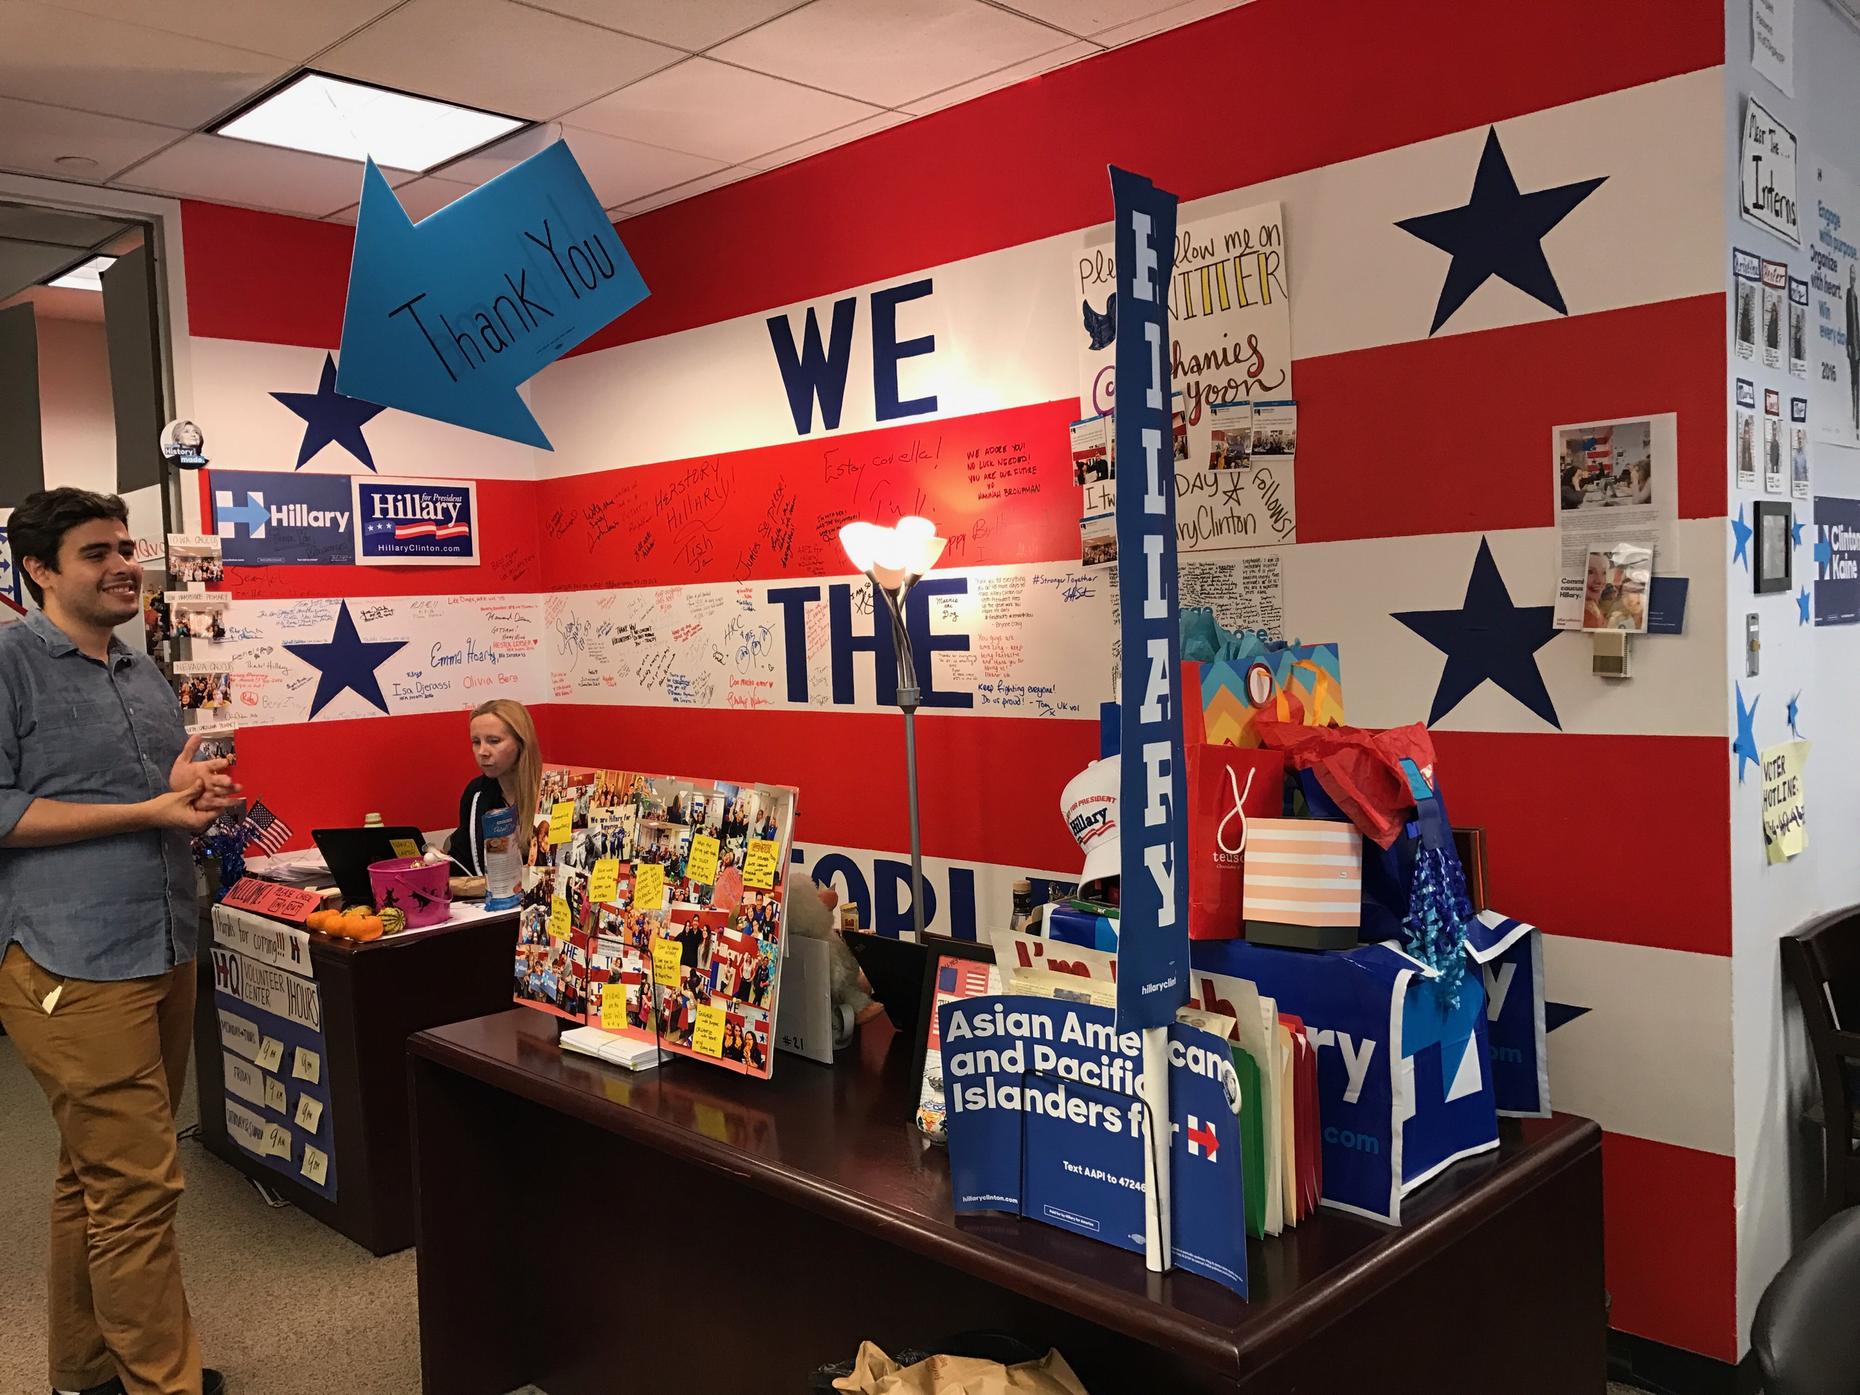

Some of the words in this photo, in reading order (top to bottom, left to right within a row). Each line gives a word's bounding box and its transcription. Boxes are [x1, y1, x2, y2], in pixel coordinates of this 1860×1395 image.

[1225, 228, 1254, 254] me
[1259, 223, 1281, 248] on
[1810, 244, 1837, 273] Organize
[1168, 250, 1288, 320] ITTER
[388, 267, 555, 383] Thank
[524, 218, 616, 300] You
[766, 277, 938, 436] WE
[1186, 368, 1286, 427] yoon
[164, 447, 193, 456] History
[966, 449, 980, 460] WE
[984, 444, 1008, 457] ADORE
[967, 461, 976, 471] NO
[967, 475, 981, 484] YOU
[983, 471, 997, 481] ARE
[433, 494, 463, 503] President
[1085, 486, 1099, 511] I
[1175, 471, 1219, 498] DAY
[271, 504, 350, 532] Hillary
[371, 493, 463, 528] Hillary
[377, 544, 461, 553] HillaryClinton.com
[1831, 524, 1860, 551] Clinton
[1832, 553, 1858, 580] Kaine
[1561, 577, 1584, 586] Commi
[430, 641, 463, 668] Emma
[767, 577, 974, 708] THE
[392, 683, 414, 697] Isa
[415, 680, 452, 696] Djerassi
[463, 674, 493, 689] Olivia
[981, 694, 991, 705] Do
[1057, 702, 1068, 711] UK
[1763, 755, 1786, 782] VOTER
[1078, 795, 1117, 808] PRESIDENT
[1069, 807, 1108, 836] Hillary
[243, 960, 286, 993] VOLUNTEER
[244, 983, 271, 1007] CENTER
[946, 1002, 1054, 1043] Asian
[950, 1040, 1025, 1077] and
[952, 1075, 1122, 1134] Islanders
[1062, 1160, 1084, 1177] Text
[1084, 1166, 1106, 1185] AAPI
[1107, 1172, 1118, 1185] to
[962, 1194, 1019, 1205] hillaryclinton.com
